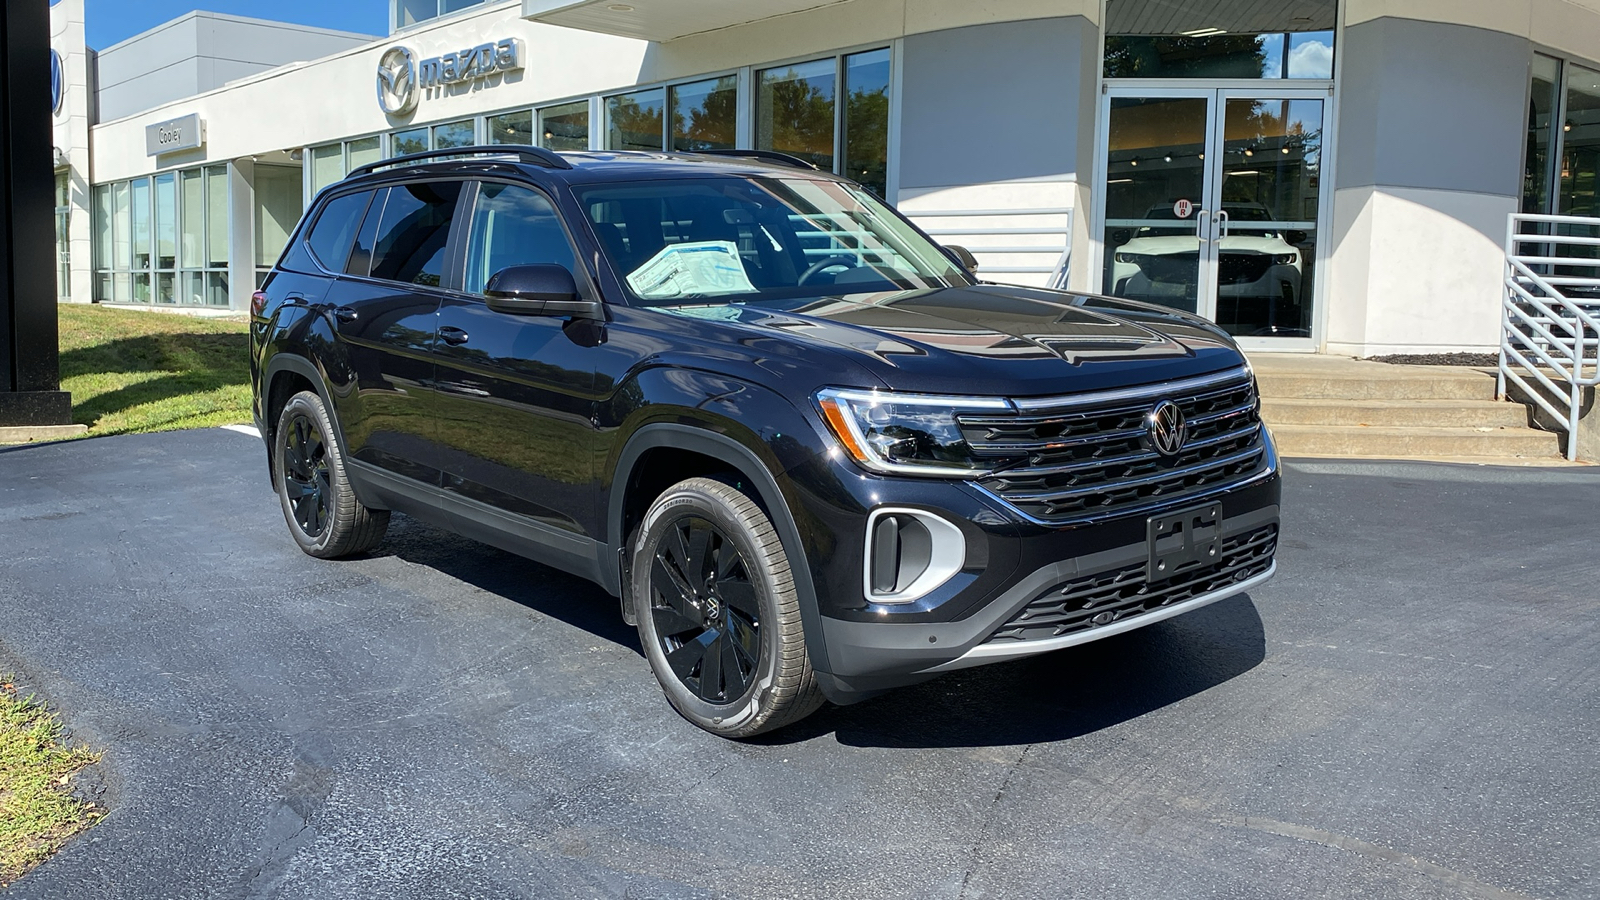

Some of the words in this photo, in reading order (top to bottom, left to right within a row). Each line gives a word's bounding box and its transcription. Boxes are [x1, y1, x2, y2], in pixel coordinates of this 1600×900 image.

[420, 37, 523, 88] mazda
[158, 122, 182, 146] Cooley
[1180, 208, 1186, 216] R
